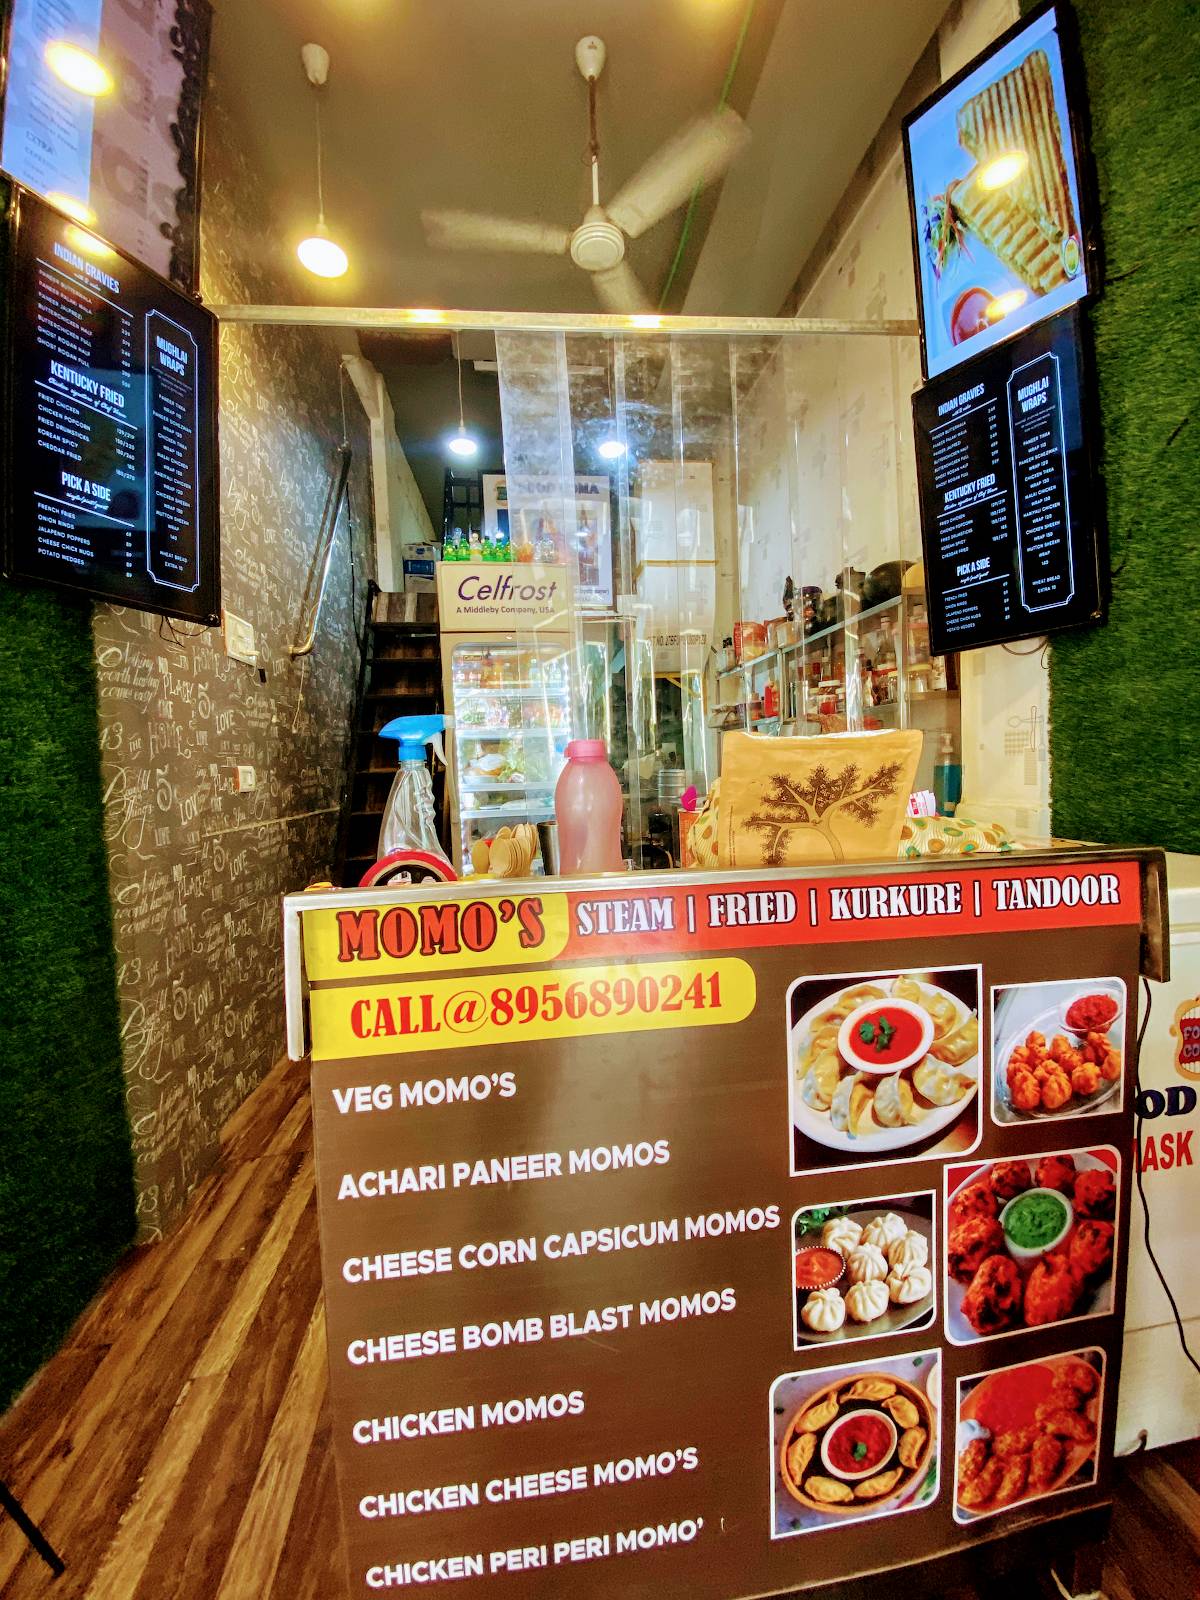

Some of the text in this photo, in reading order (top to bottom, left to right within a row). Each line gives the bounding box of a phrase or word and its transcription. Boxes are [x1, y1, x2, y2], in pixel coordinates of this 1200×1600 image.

[54, 241, 83, 271] INDIAN
[86, 262, 120, 294] GRAVIES
[156, 335, 188, 365] MUGHLAI
[160, 351, 185, 376] WRAPS
[51, 360, 99, 395] KENTUCKY
[100, 384, 125, 408] FRIED
[1017, 375, 1049, 402] MUGHLAI
[38, 392, 80, 415] FRIED CHICKEN
[938, 396, 958, 417] INDIAN
[959, 382, 985, 406] GRAVIES
[1021, 391, 1047, 413] WRAPS
[38, 404, 91, 431] CHICKEN POPCORN
[38, 416, 54, 427] FRIED
[38, 428, 78, 448] KOREAN SPICY
[38, 440, 82, 461] CHEDDAR FRIED
[61, 471, 82, 492] PICK
[84, 480, 91, 494] A
[91, 482, 111, 502] SIDE
[944, 480, 976, 504] KENTUCKY
[977, 473, 996, 491] FRIED
[38, 502, 76, 519] FRENCH FRIES
[38, 514, 75, 530] ONION RINGS
[38, 525, 91, 546] JALAPENO POPPERS
[38, 537, 60, 548] CHEESE
[1026, 526, 1044, 535] CHICKEN
[38, 547, 85, 566] POTATO WEDGES
[957, 556, 991, 577] PICK A SIDE
[458, 575, 557, 601] Celfrost
[463, 606, 499, 615] Middleby
[336, 874, 1120, 963] MOMO'S STEAM FRIED KURKURE TANDOOR
[350, 971, 723, 1039] CALL@8956890241
[332, 1071, 517, 1114] VEG MOMO'S
[1132, 1130, 1194, 1173] ASK
[337, 1140, 670, 1200] ACHARI PANEER MOMOS
[342, 1205, 781, 1284] CHEESE CORN CAPSICUM MOMOS
[347, 1288, 737, 1365] CHEESE BOMB BLAST MOMOS
[353, 1390, 585, 1444] CHICKEN MOMOS
[359, 1447, 699, 1519] CHICKEN CHEESE MOMO'S
[365, 1553, 484, 1589] CHICKEN
[490, 1545, 548, 1573] PERI
[554, 1535, 610, 1565] PERI
